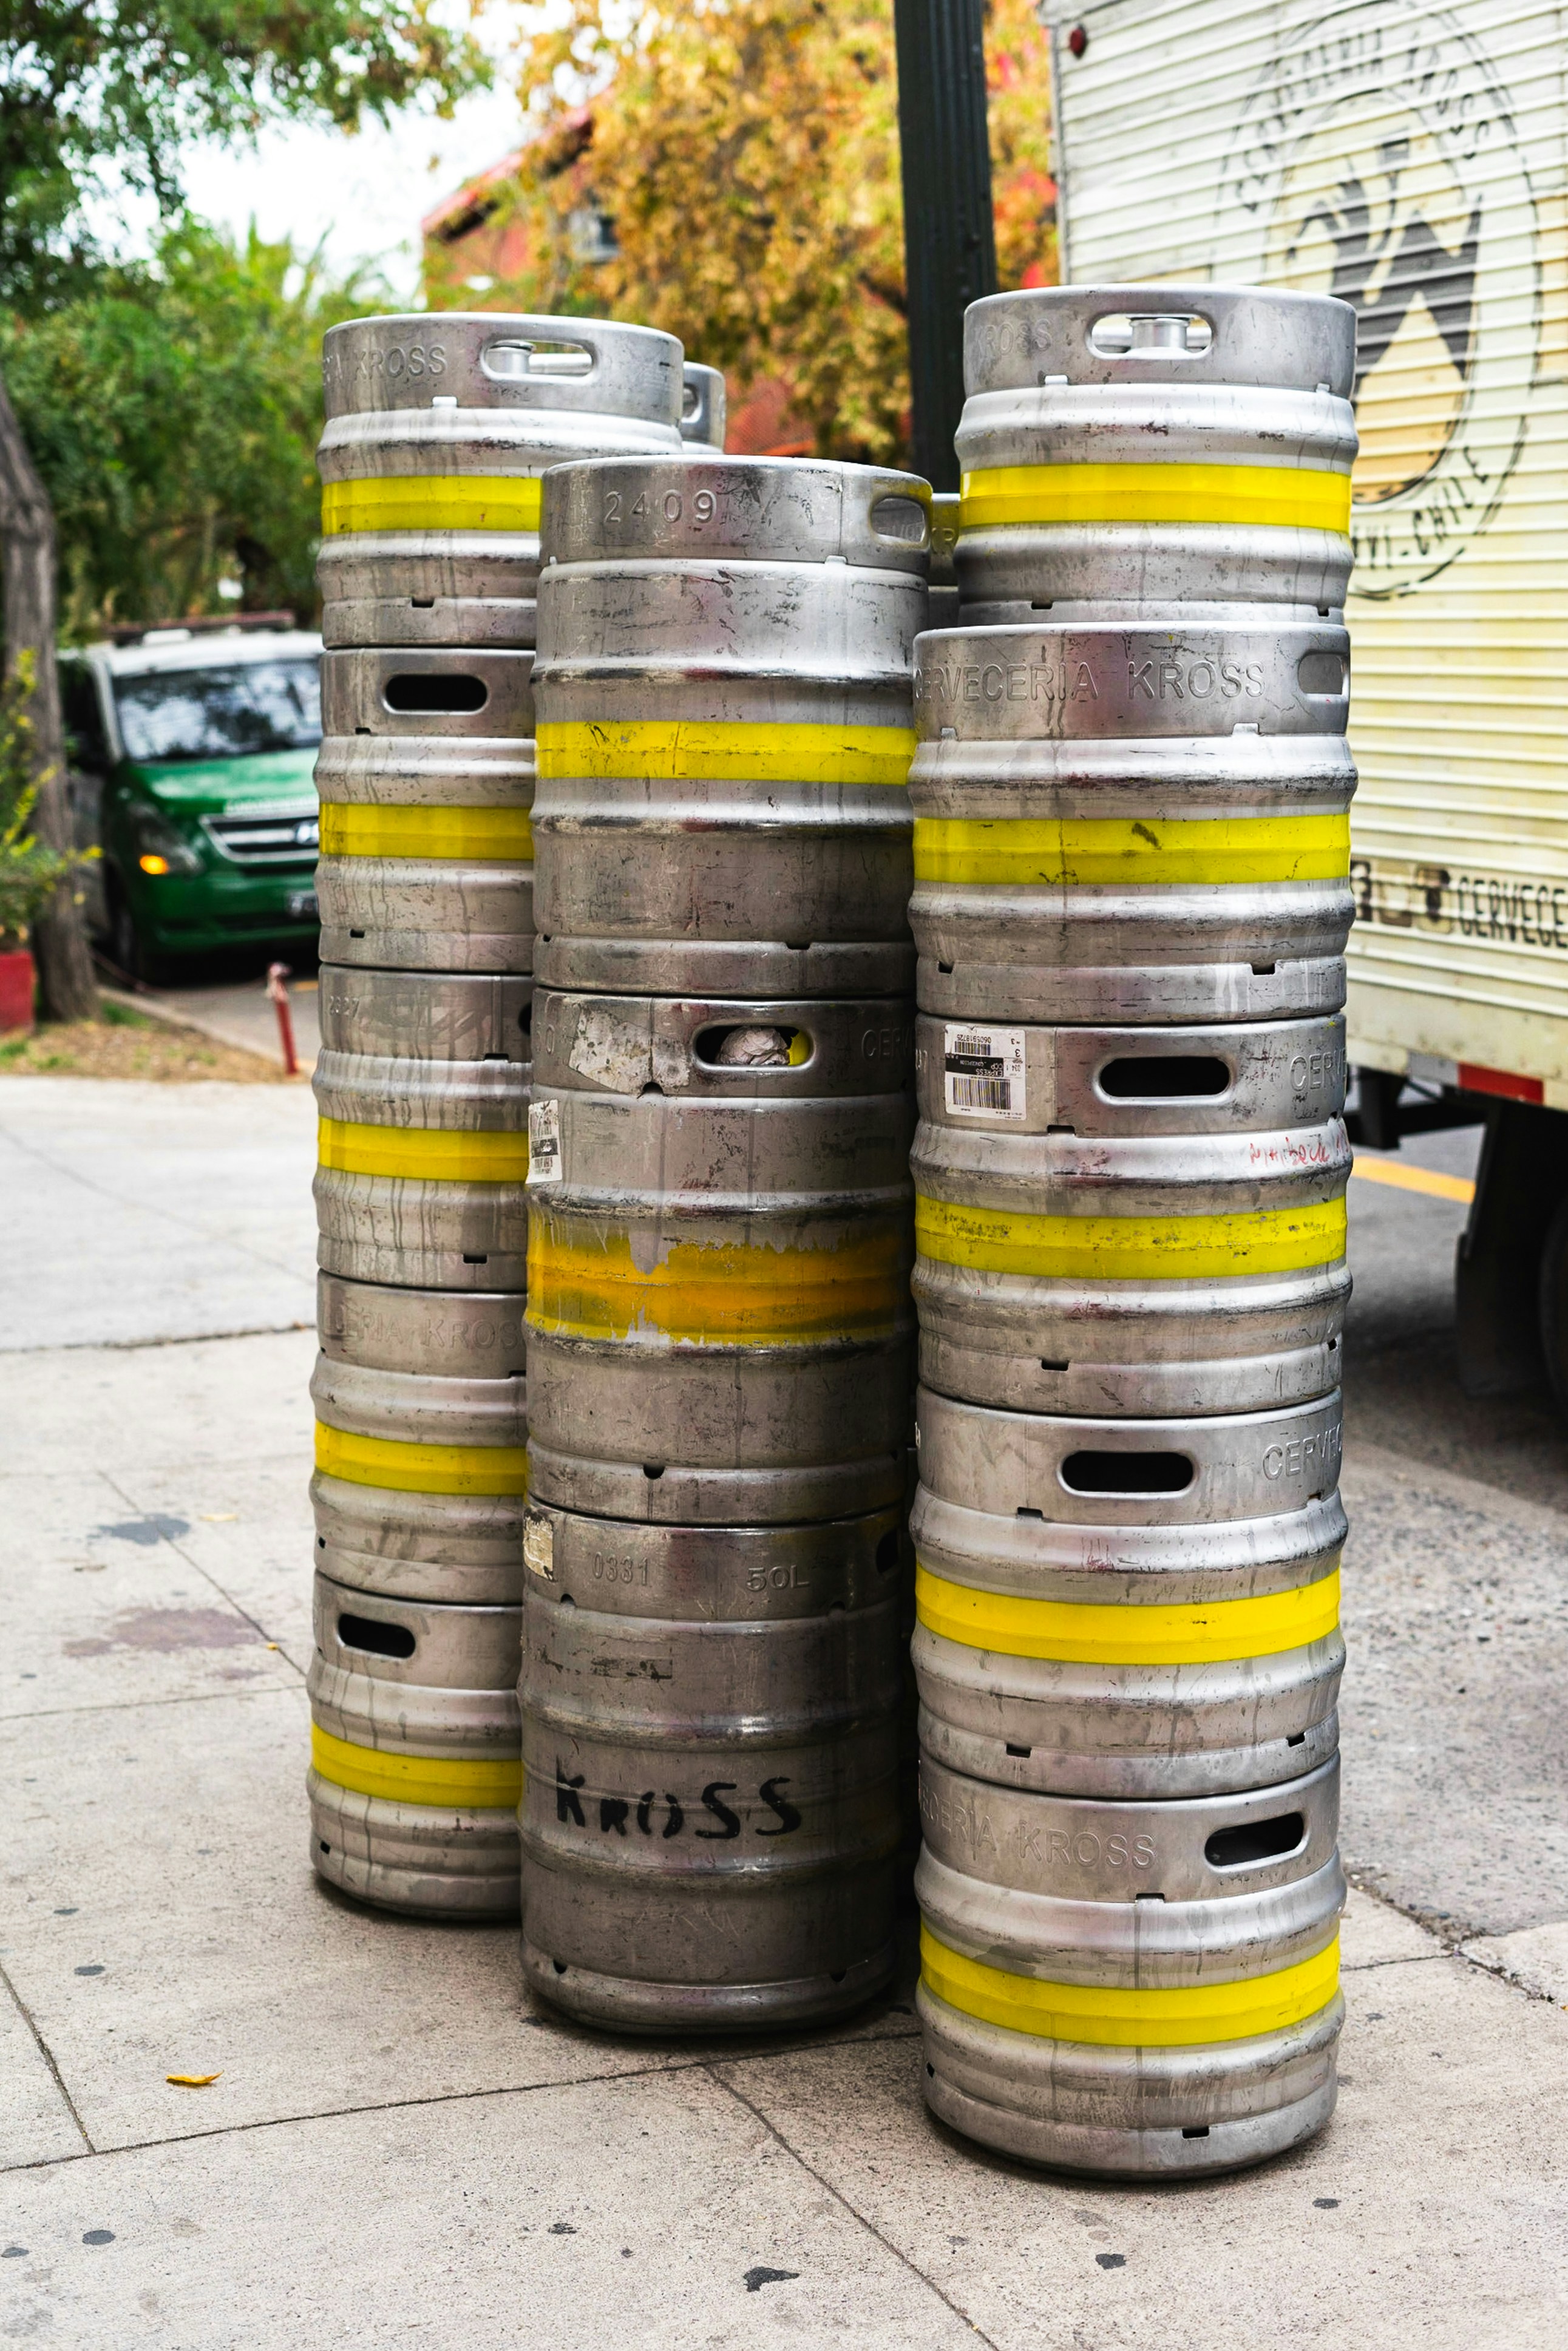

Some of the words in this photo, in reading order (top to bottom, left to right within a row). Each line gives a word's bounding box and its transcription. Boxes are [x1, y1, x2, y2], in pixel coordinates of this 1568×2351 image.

[353, 345, 448, 381] KROSS
[604, 489, 718, 524] 2409
[1128, 660, 1266, 699] KROSS
[592, 1551, 649, 1587] 0331
[745, 1564, 810, 1592] 50L
[555, 1756, 802, 1839] KROSS
[1018, 1820, 1155, 1870] KROSS
